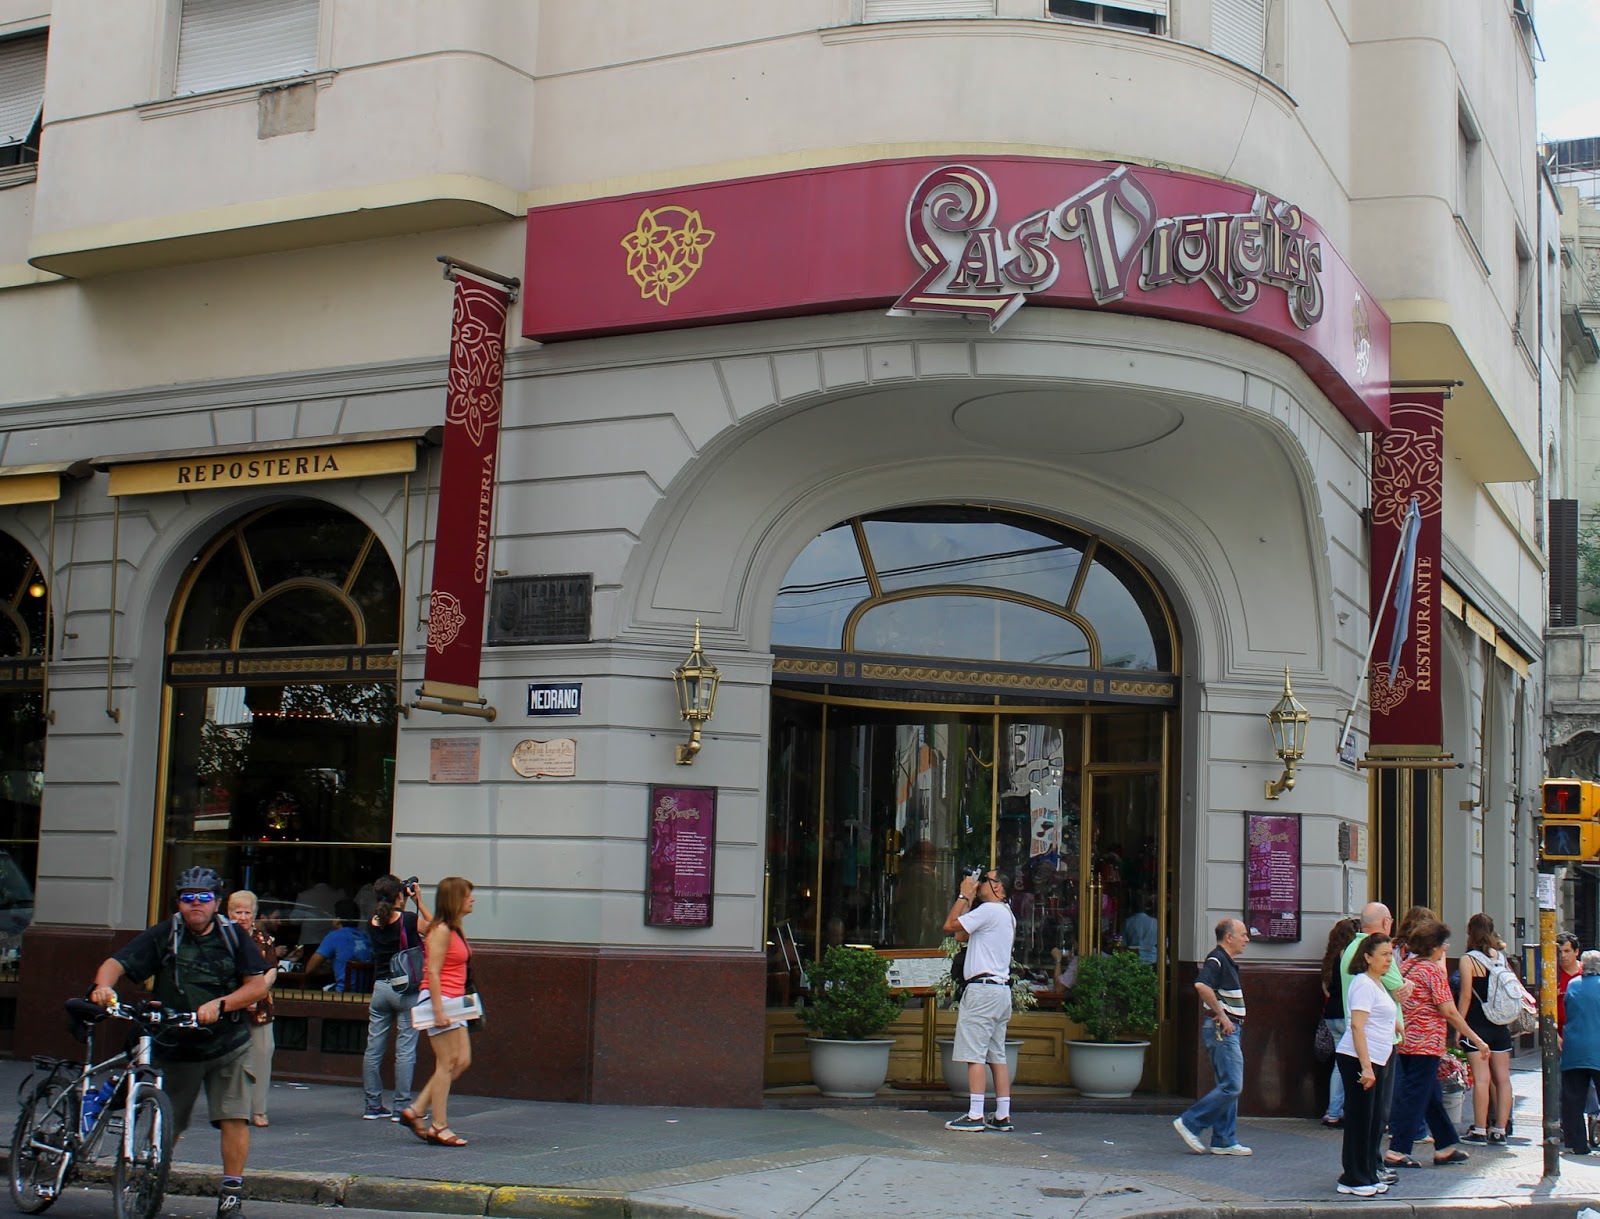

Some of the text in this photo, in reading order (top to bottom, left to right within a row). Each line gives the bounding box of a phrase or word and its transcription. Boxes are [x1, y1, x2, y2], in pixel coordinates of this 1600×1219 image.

[177, 453, 340, 484] REPOSTERIA
[473, 452, 494, 585] CONFITERIA
[1416, 556, 1432, 692] RESTAURANTE
[530, 688, 578, 710] MEDRANO
